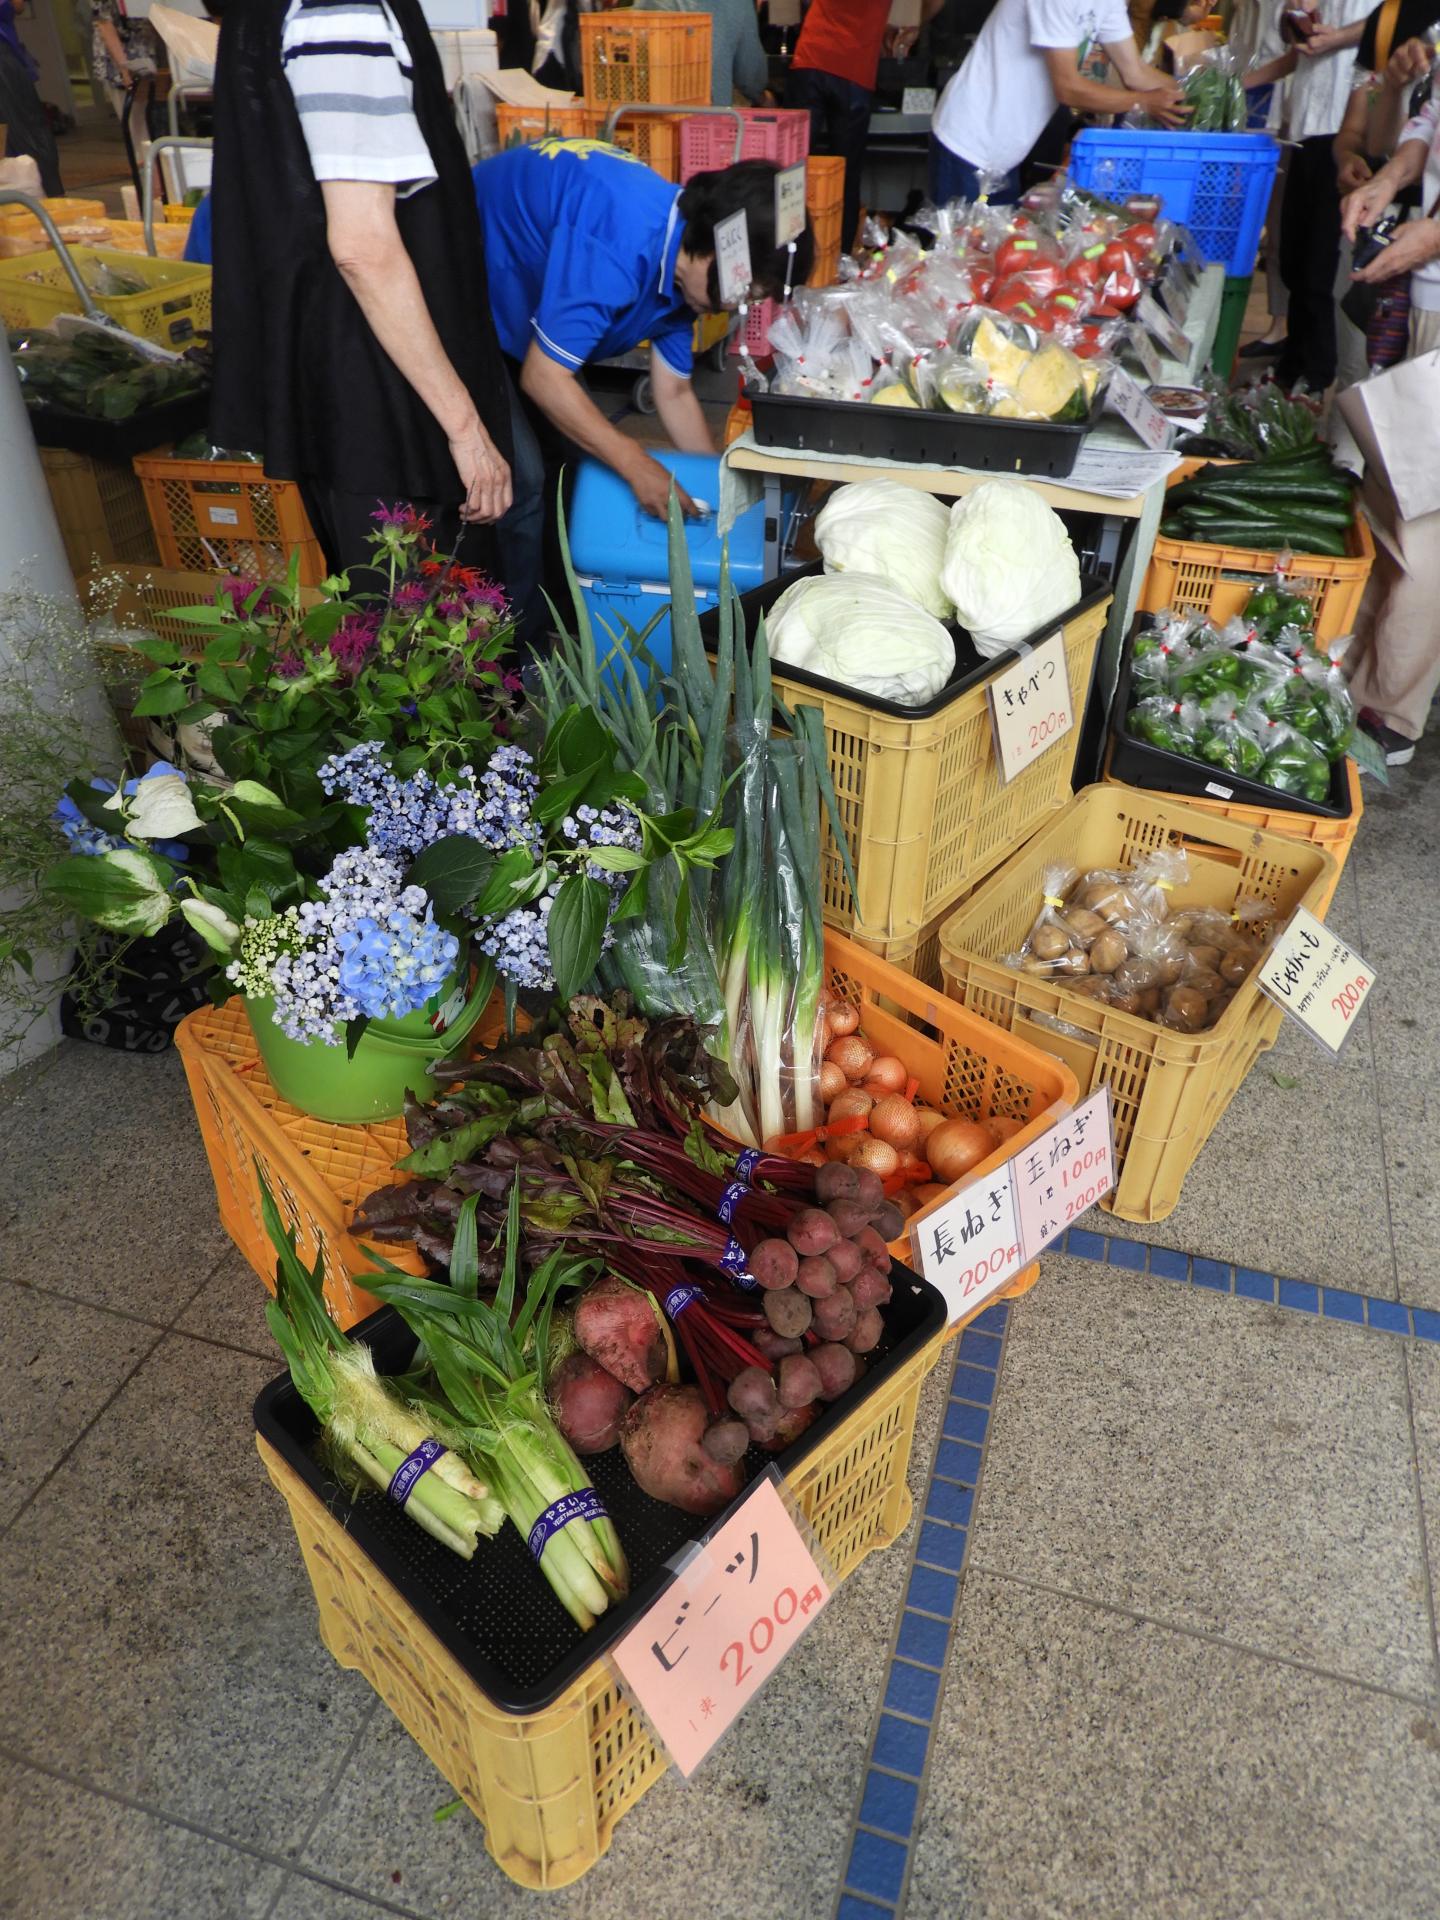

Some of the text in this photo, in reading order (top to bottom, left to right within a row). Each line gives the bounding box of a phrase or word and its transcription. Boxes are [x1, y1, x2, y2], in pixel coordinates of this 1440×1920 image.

[1028, 711, 1067, 749] 200円
[1271, 929, 1320, 996] じゃがいも
[1331, 975, 1370, 1021] 200円
[1025, 1110, 1093, 1186] 玉ねぎ
[1062, 1147, 1106, 1188] 100円
[930, 1185, 1009, 1266] 長ねぎ
[1065, 1175, 1108, 1221] 200円
[958, 1242, 1022, 1297] 200円
[545, 1496, 579, 1521] やさい
[651, 1531, 759, 1672] ビーツ
[719, 1584, 823, 1687] 200円
